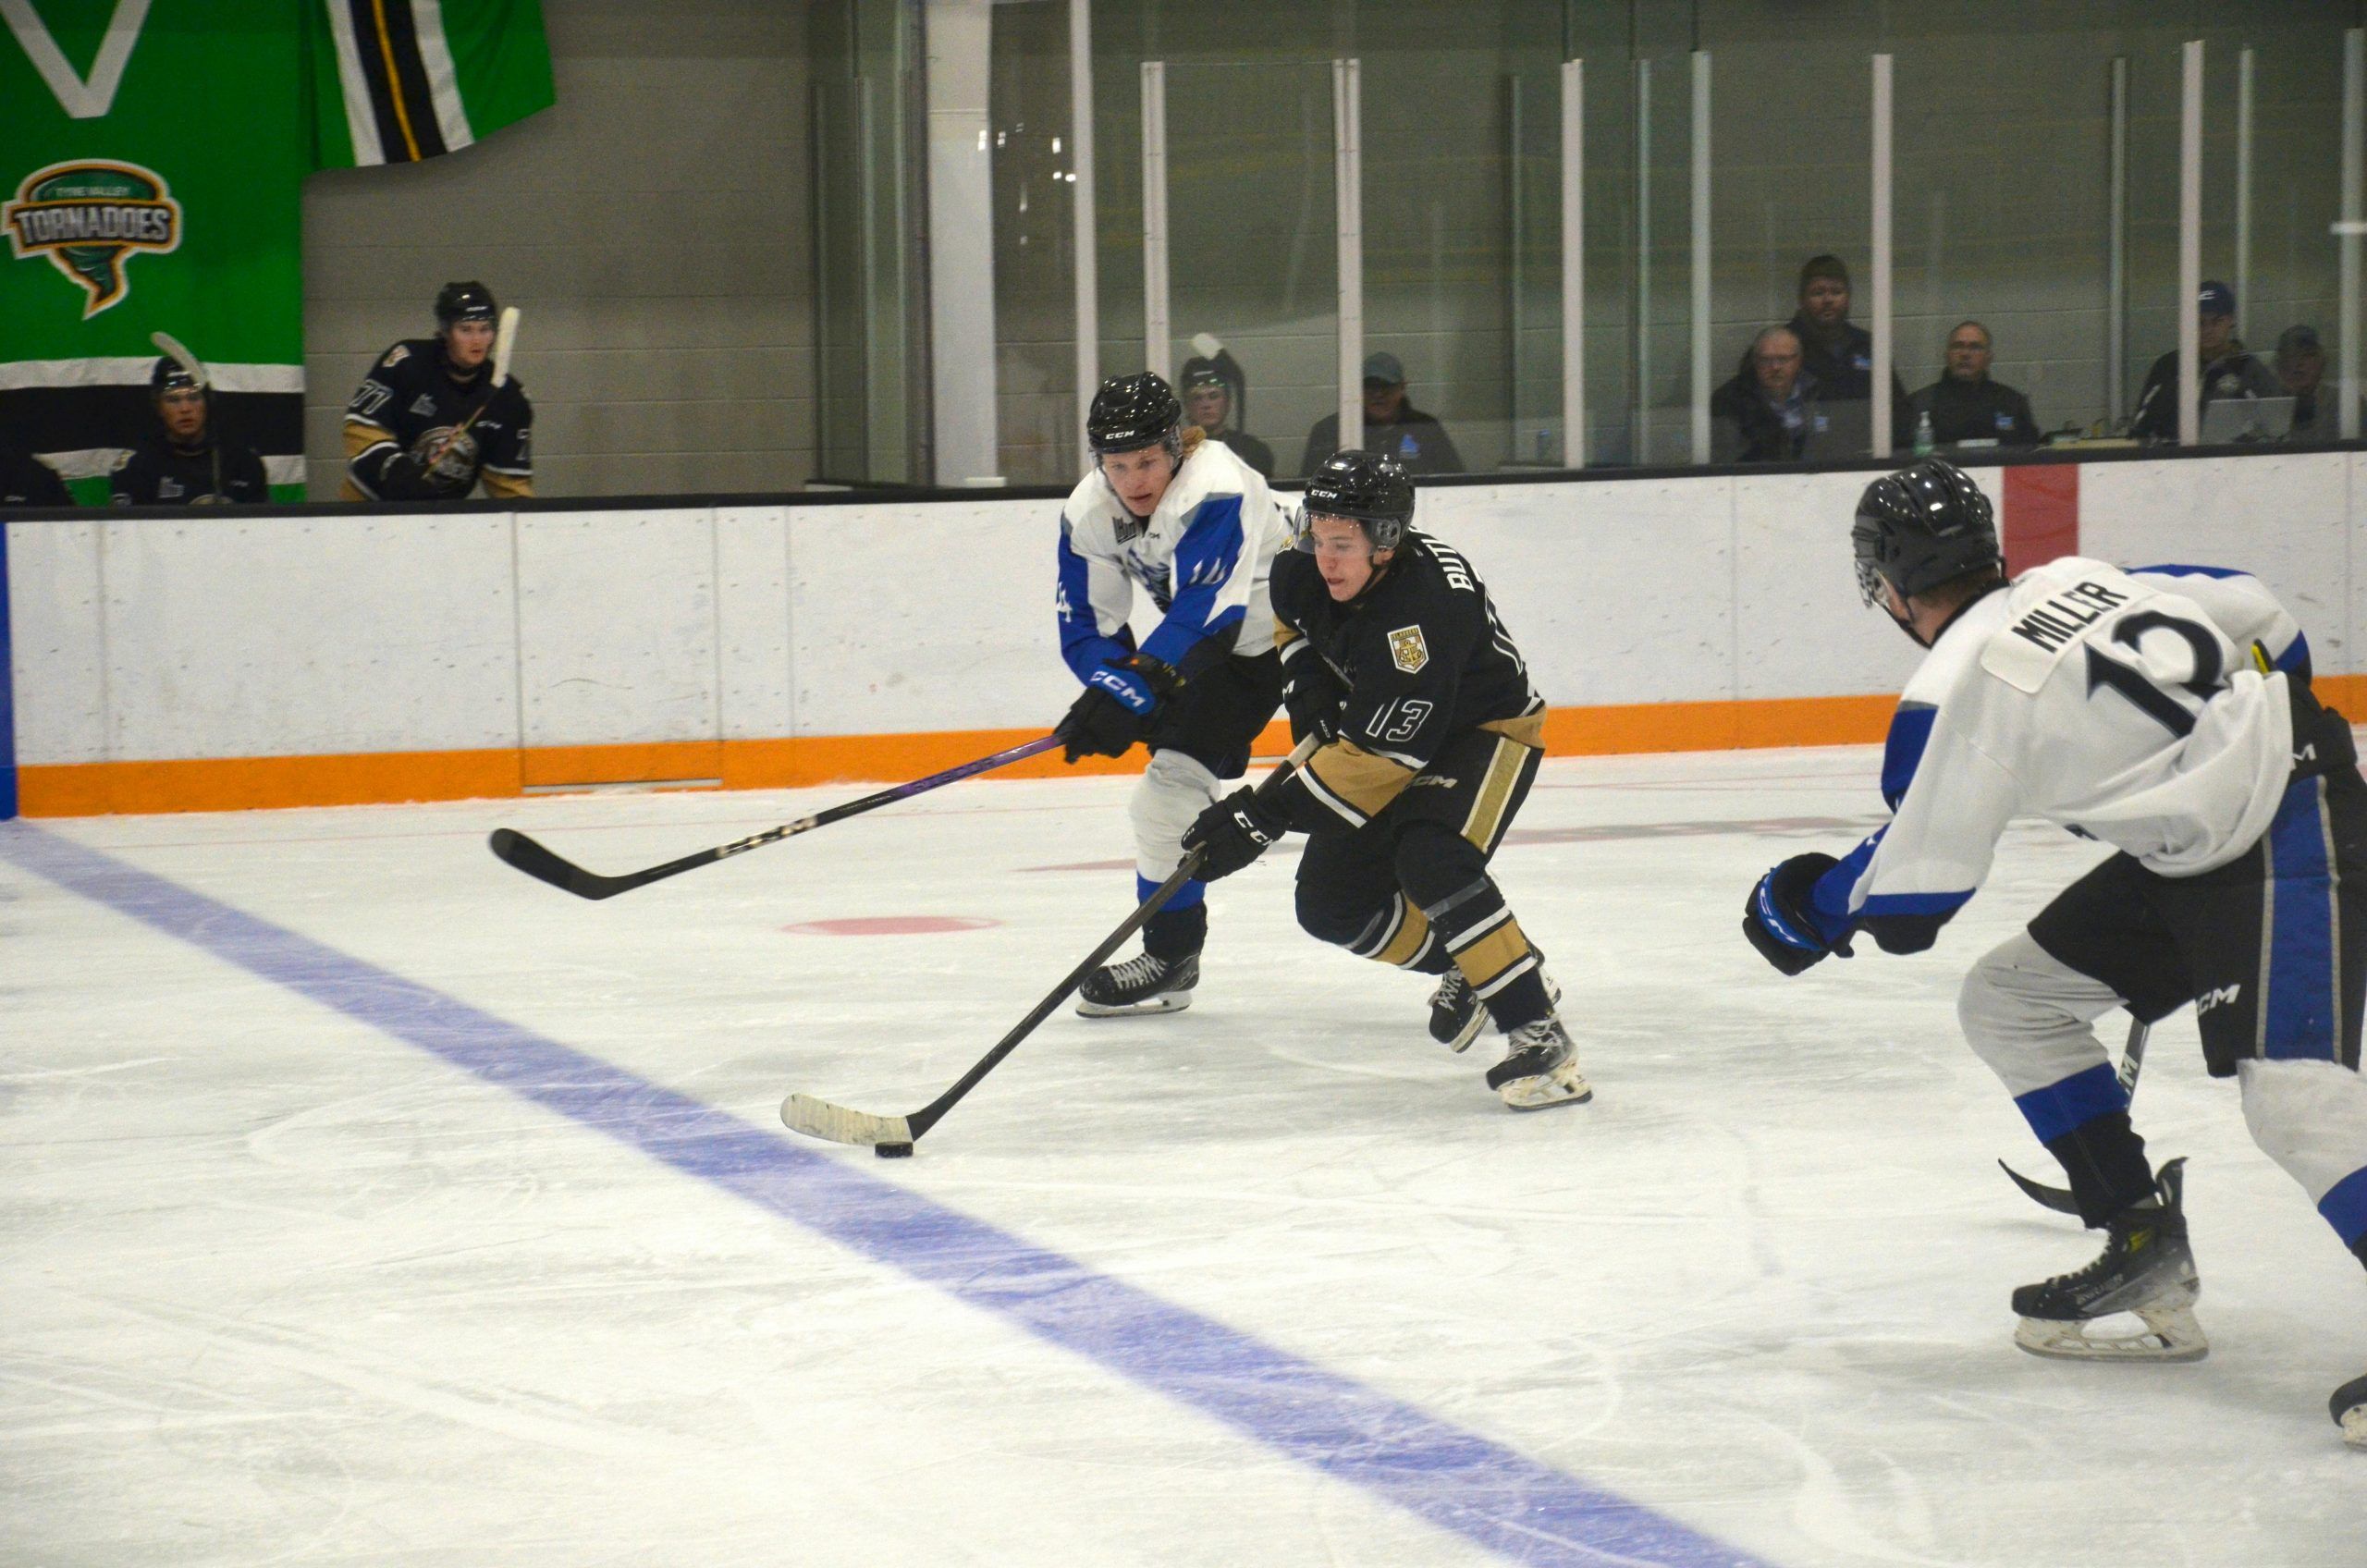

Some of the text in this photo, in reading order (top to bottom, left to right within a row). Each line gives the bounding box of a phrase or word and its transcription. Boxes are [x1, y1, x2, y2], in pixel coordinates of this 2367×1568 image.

[15, 206, 170, 244] TORNADOES
[1105, 430, 1135, 440] CCM
[1310, 489, 1338, 500] CCM
[2010, 581, 2129, 655] MILLER
[1090, 670, 1147, 708] CCM
[1366, 696, 1433, 742] 13
[1410, 775, 1458, 789] CM
[2196, 983, 2241, 1017] CM
